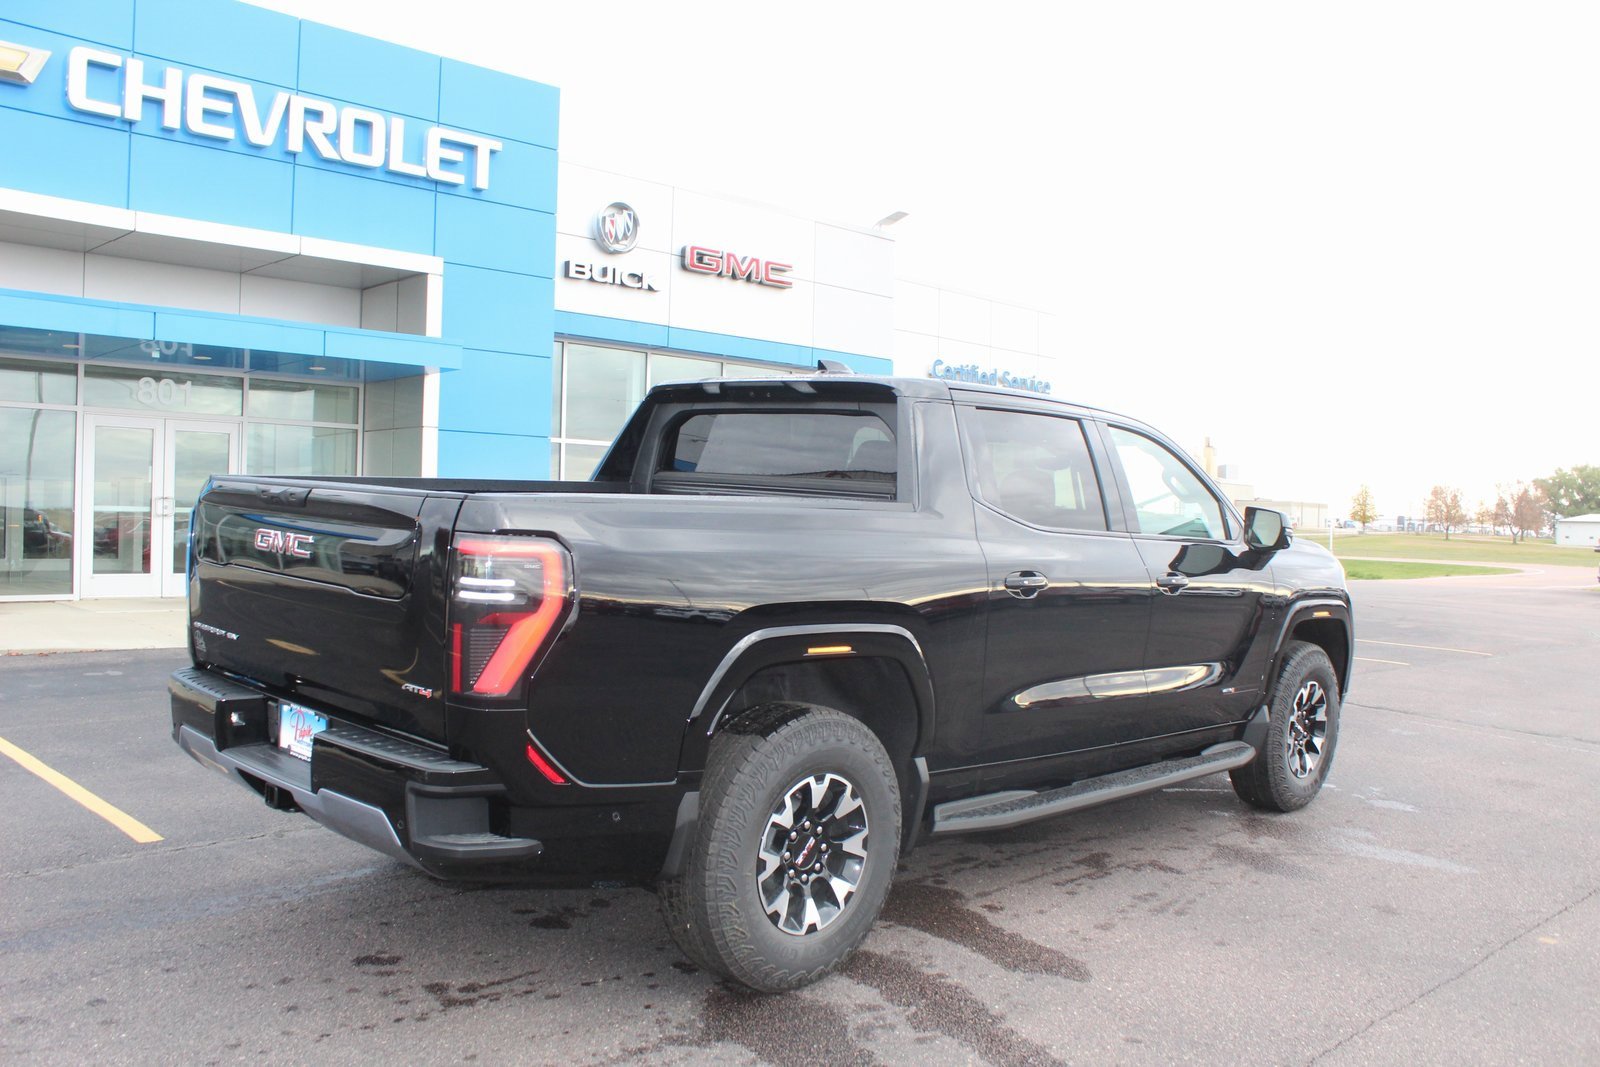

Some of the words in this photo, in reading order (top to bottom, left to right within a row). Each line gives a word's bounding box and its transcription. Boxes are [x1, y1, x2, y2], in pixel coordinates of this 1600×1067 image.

[66, 46, 503, 191] CHEVROLET
[564, 259, 660, 292] BUICK
[682, 245, 793, 289] GMC
[137, 376, 192, 408] 801
[931, 358, 998, 387] Certified
[1000, 370, 1051, 395] Service
[254, 528, 314, 559] GMC
